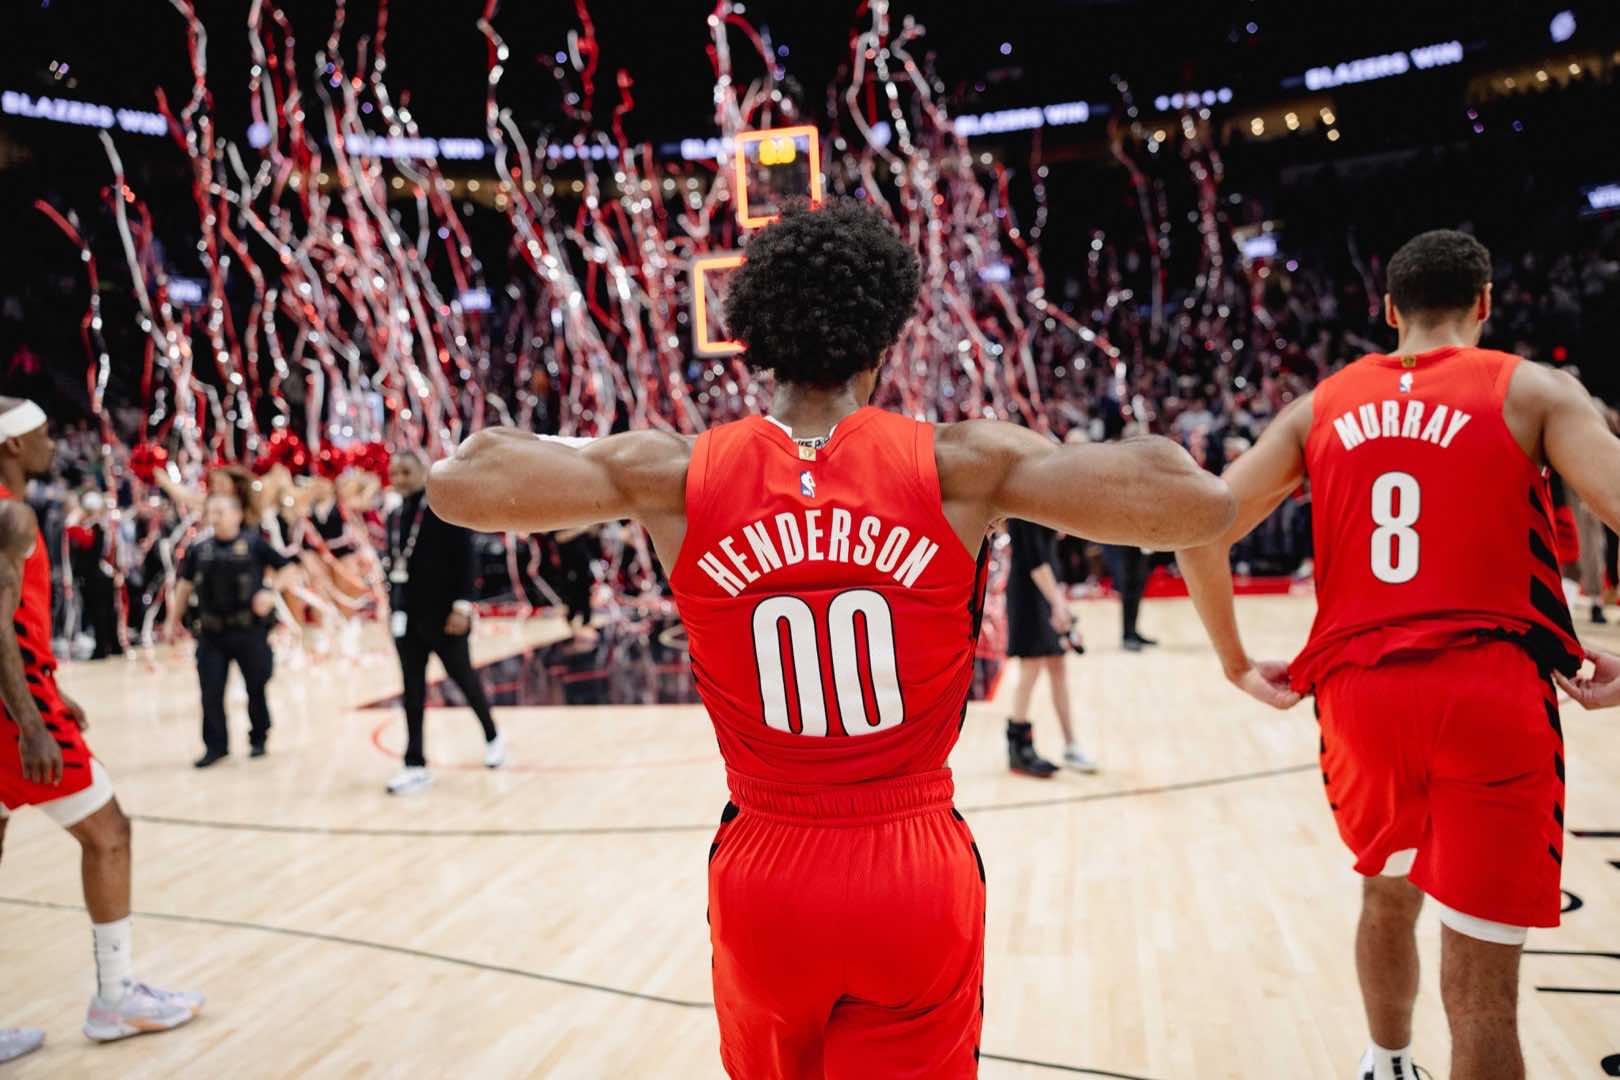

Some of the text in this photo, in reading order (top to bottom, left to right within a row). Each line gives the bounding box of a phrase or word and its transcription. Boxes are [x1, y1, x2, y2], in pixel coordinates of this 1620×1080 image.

[1333, 400, 1471, 450] MURRAY
[697, 507, 939, 598] HENDERSON
[1371, 471, 1420, 583] 8
[751, 588, 905, 737] 00
